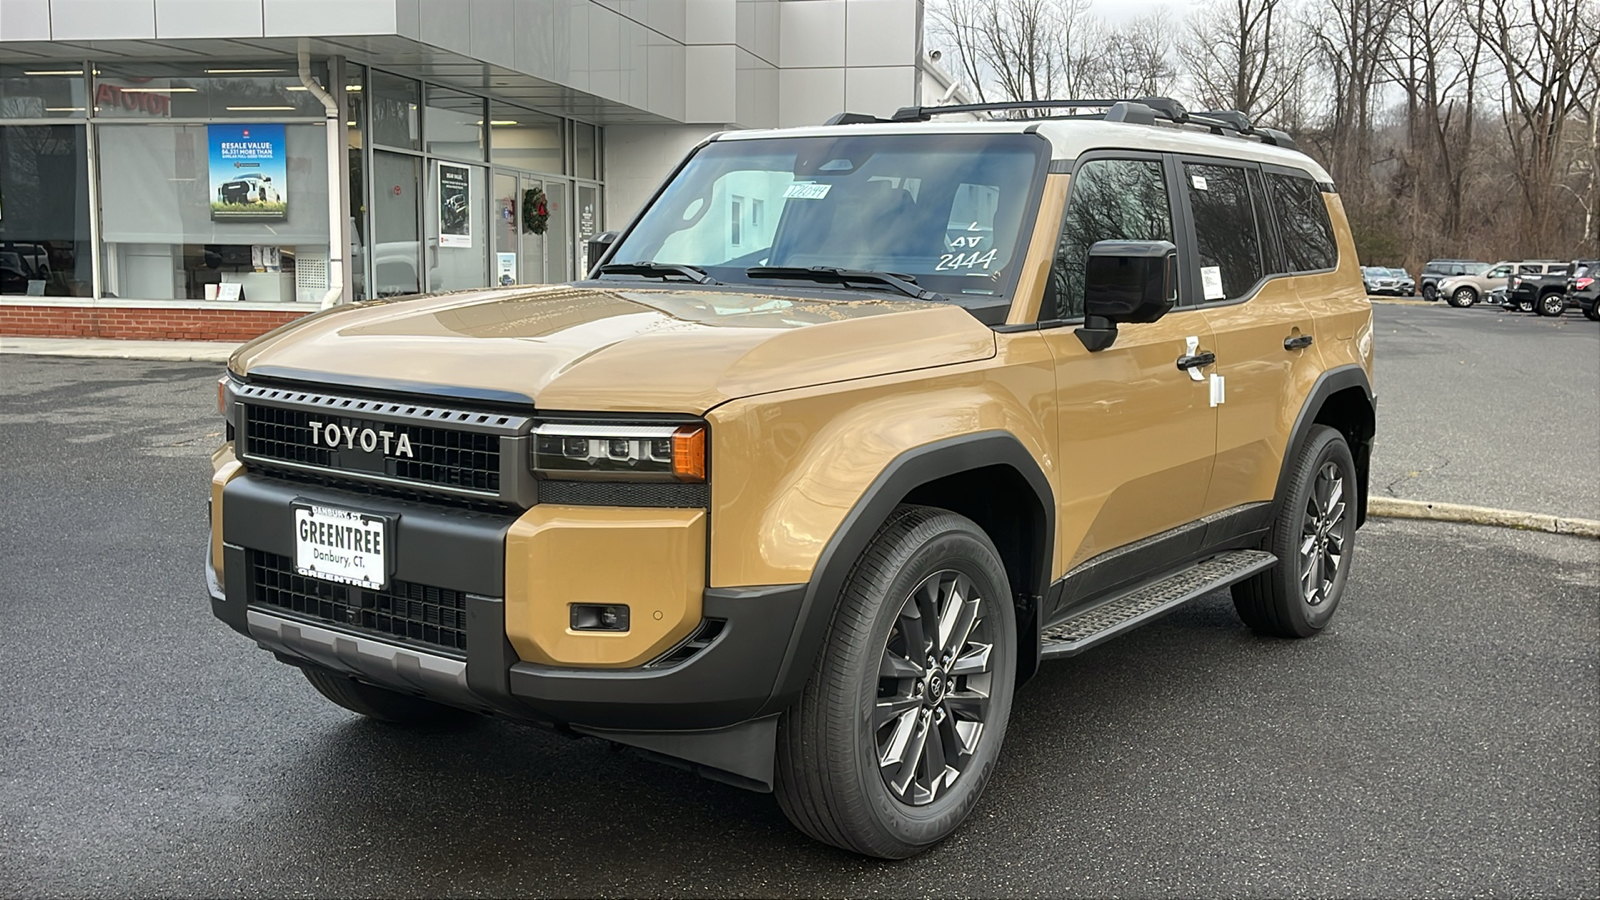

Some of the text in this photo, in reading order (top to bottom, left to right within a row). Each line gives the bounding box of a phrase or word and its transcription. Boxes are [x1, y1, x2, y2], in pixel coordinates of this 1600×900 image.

[934, 248, 998, 271] 2444
[308, 421, 414, 458] TOYOTA
[299, 518, 381, 556] GREENTREE
[313, 547, 351, 568] Danbury,
[297, 568, 381, 590] GREENTREE
